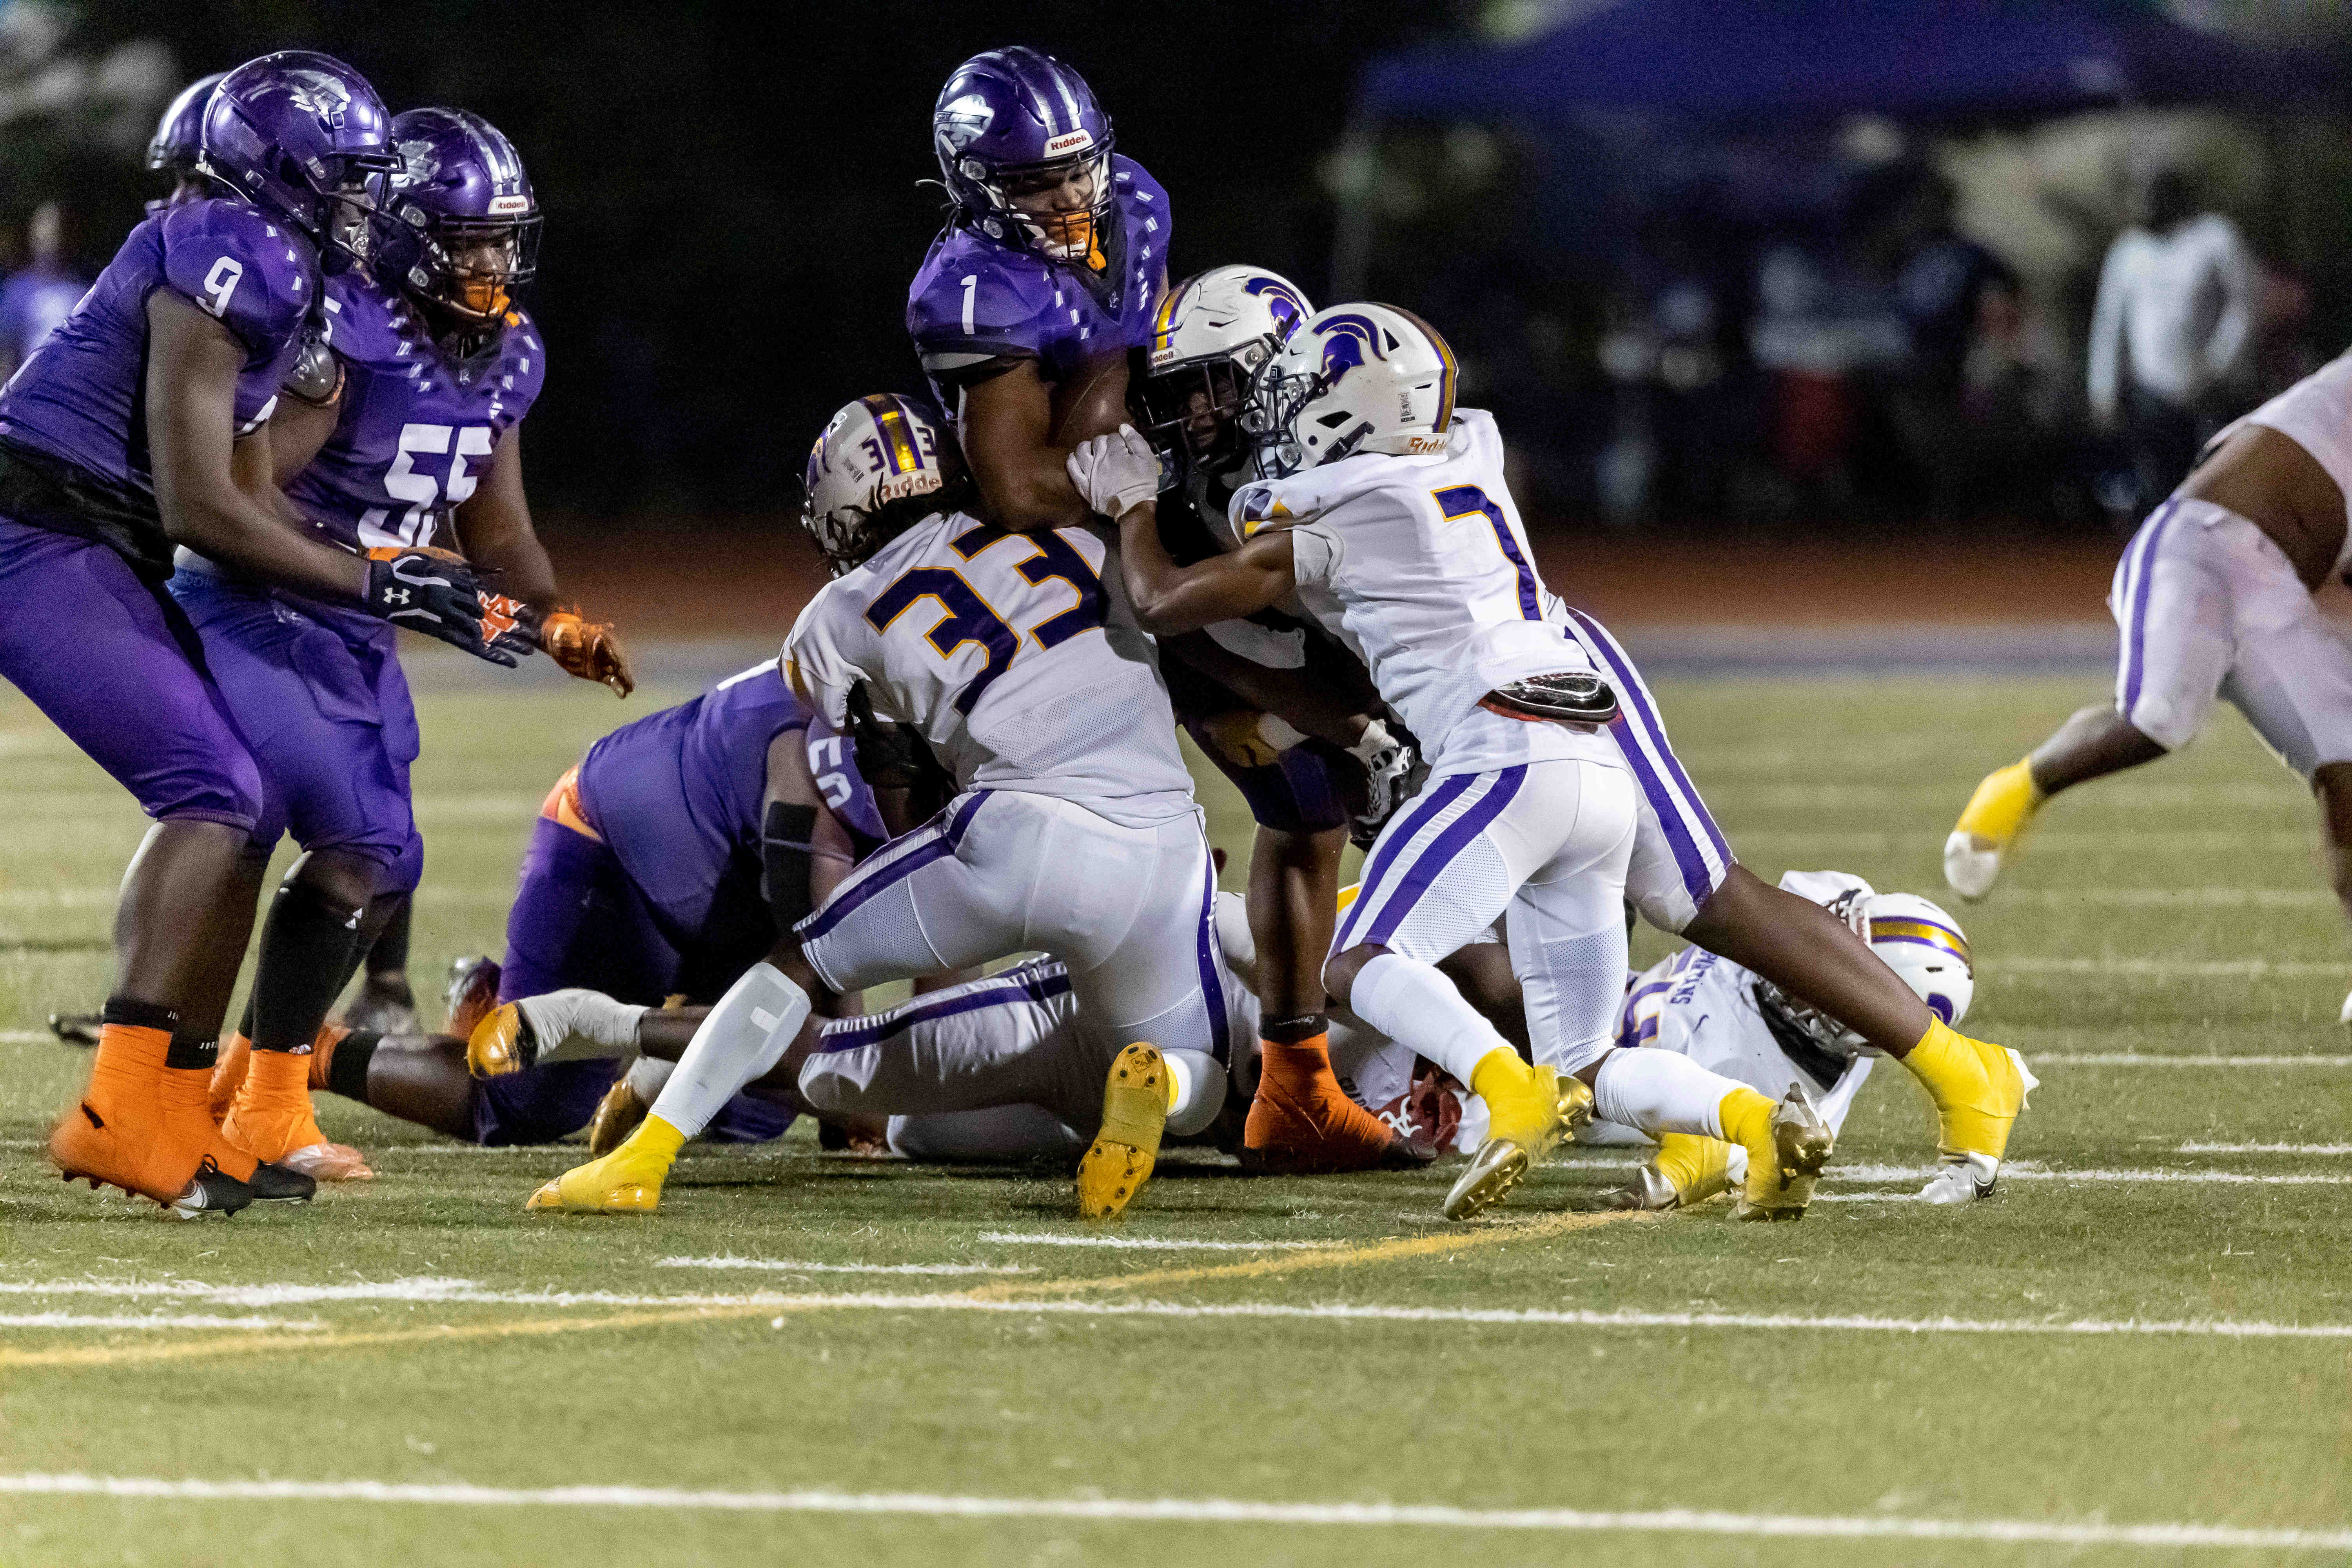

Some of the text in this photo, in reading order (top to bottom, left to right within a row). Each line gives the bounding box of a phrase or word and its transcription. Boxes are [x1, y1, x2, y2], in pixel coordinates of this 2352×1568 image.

[196, 255, 243, 318] 9
[960, 275, 977, 334] 1
[1430, 483, 1543, 621] 7
[862, 523, 1109, 720] 33
